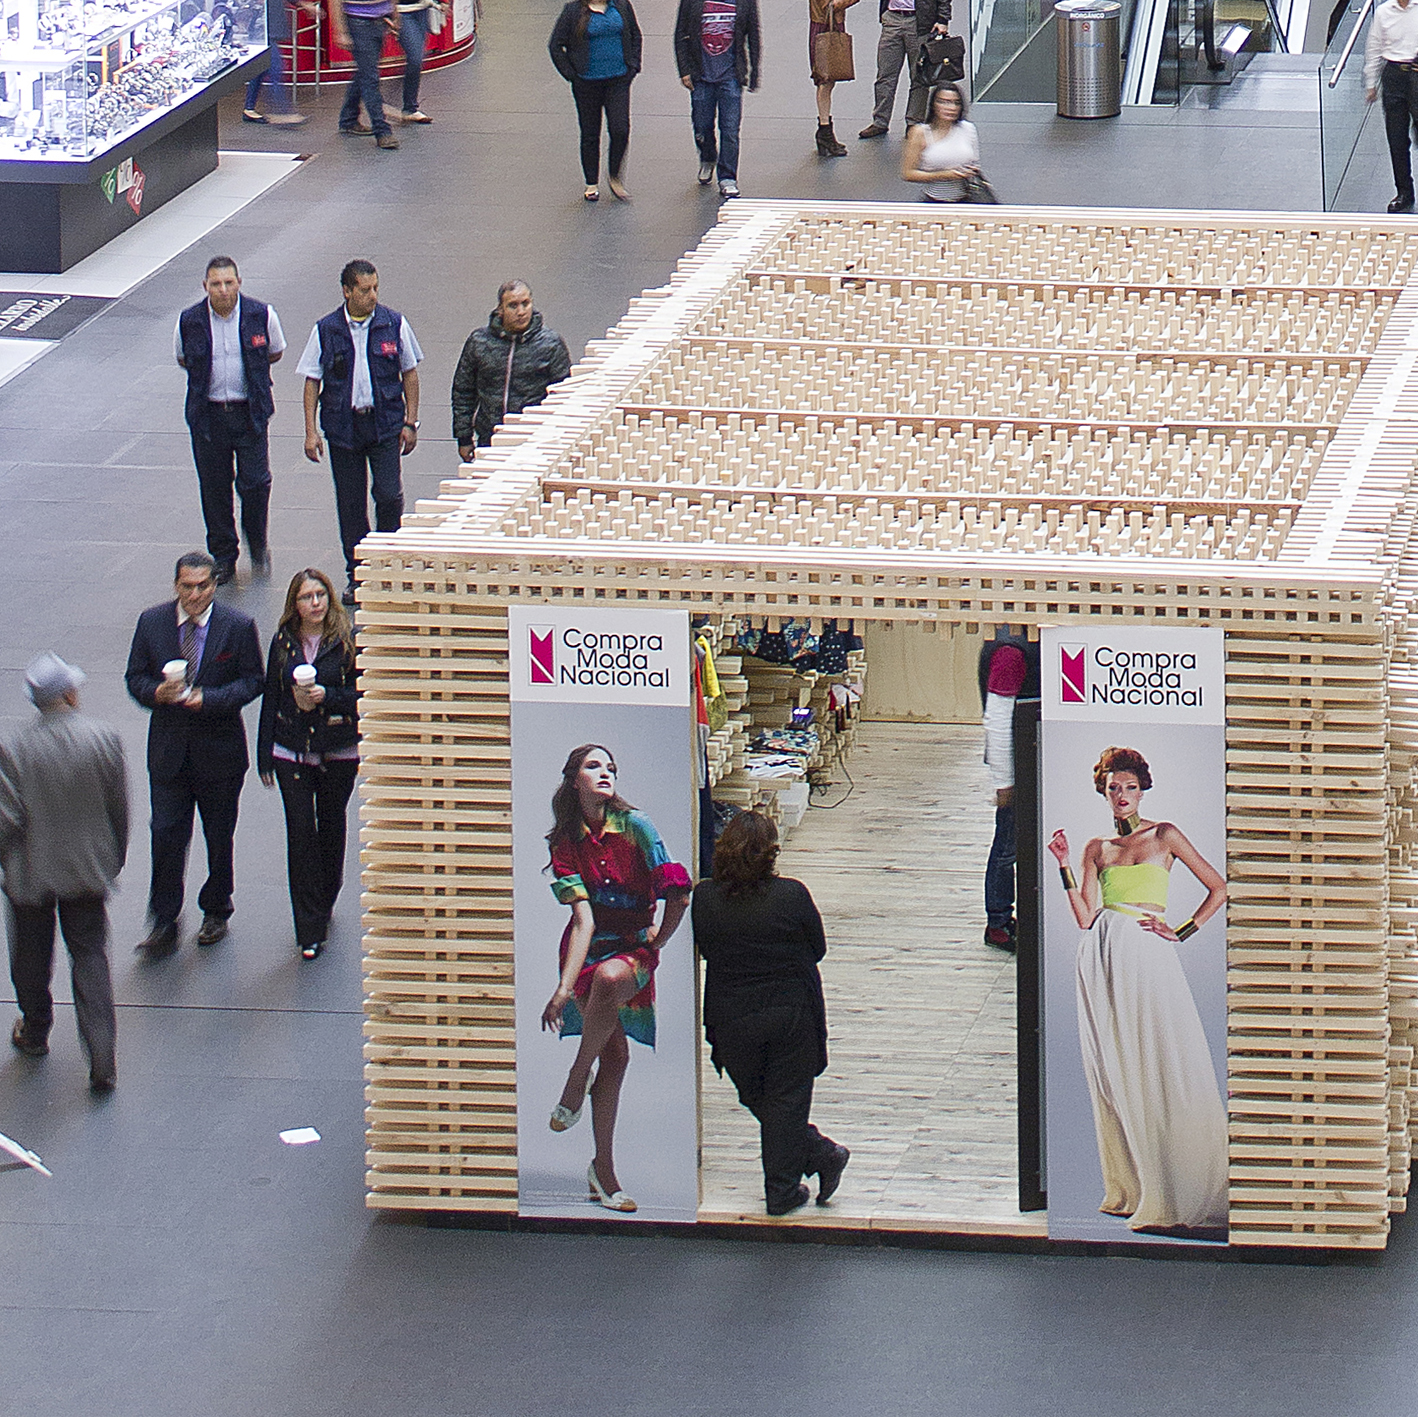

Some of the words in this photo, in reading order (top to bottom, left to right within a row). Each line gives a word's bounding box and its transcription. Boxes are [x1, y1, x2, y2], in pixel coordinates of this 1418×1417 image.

[563, 628, 663, 654] Compra
[577, 648, 648, 669] Moda
[1094, 647, 1196, 672] Compra
[560, 664, 669, 687] Nacional
[1109, 667, 1181, 688] Moda
[1092, 683, 1203, 706] Nacional
